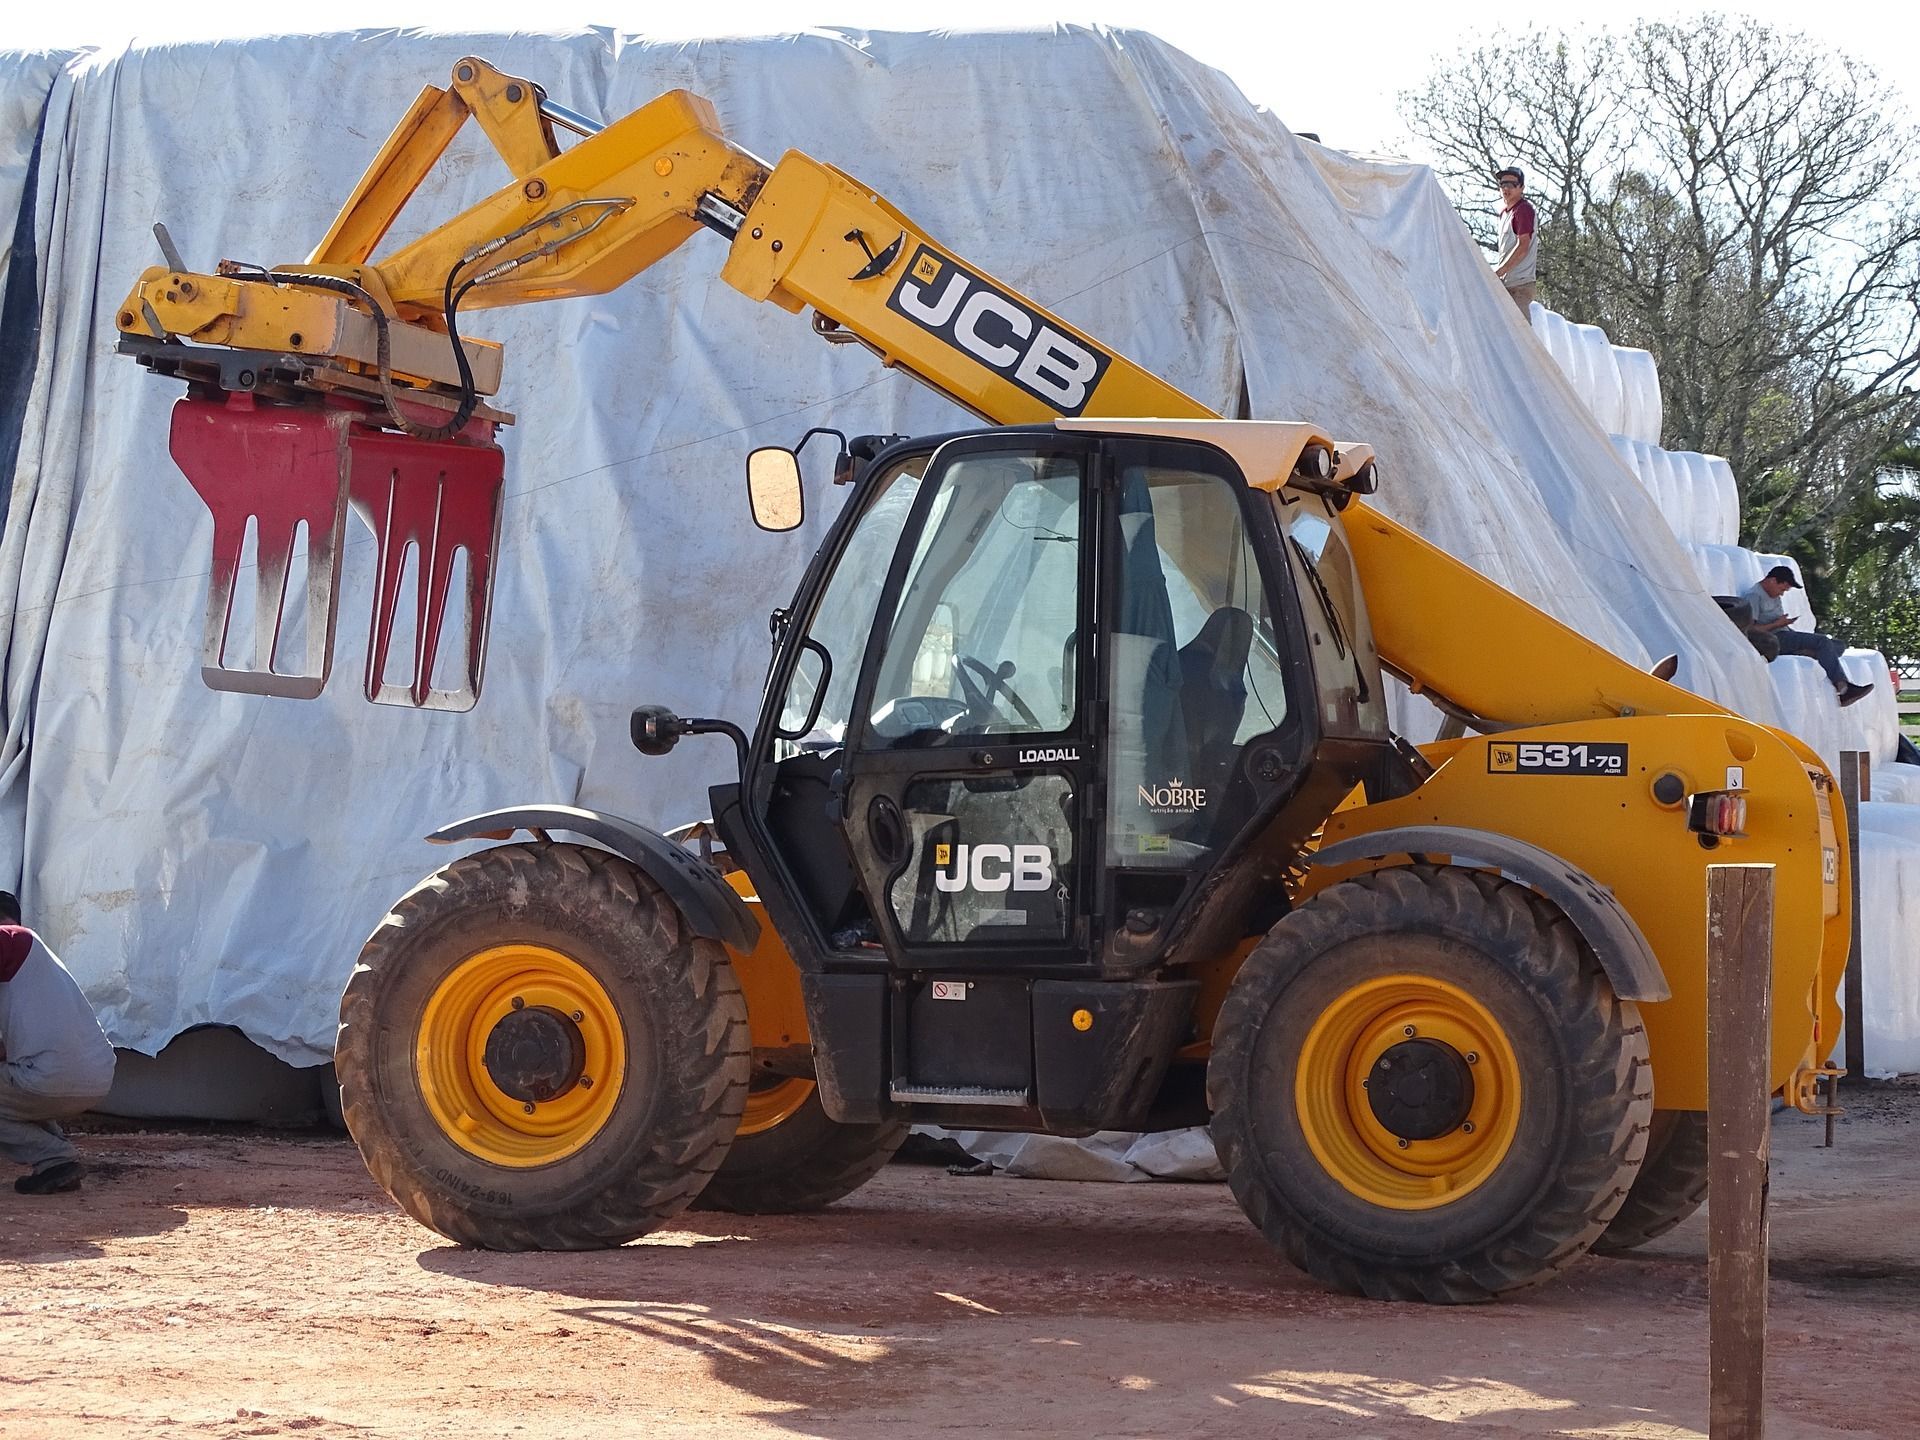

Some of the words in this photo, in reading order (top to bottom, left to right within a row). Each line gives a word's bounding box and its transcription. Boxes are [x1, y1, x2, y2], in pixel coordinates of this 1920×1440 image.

[899, 272, 1098, 409] JCB
[1019, 748, 1080, 763] LOADALL
[1519, 744, 1622, 768] 531-70
[1137, 784, 1207, 811] NOBRE
[935, 844, 1052, 893] JCB
